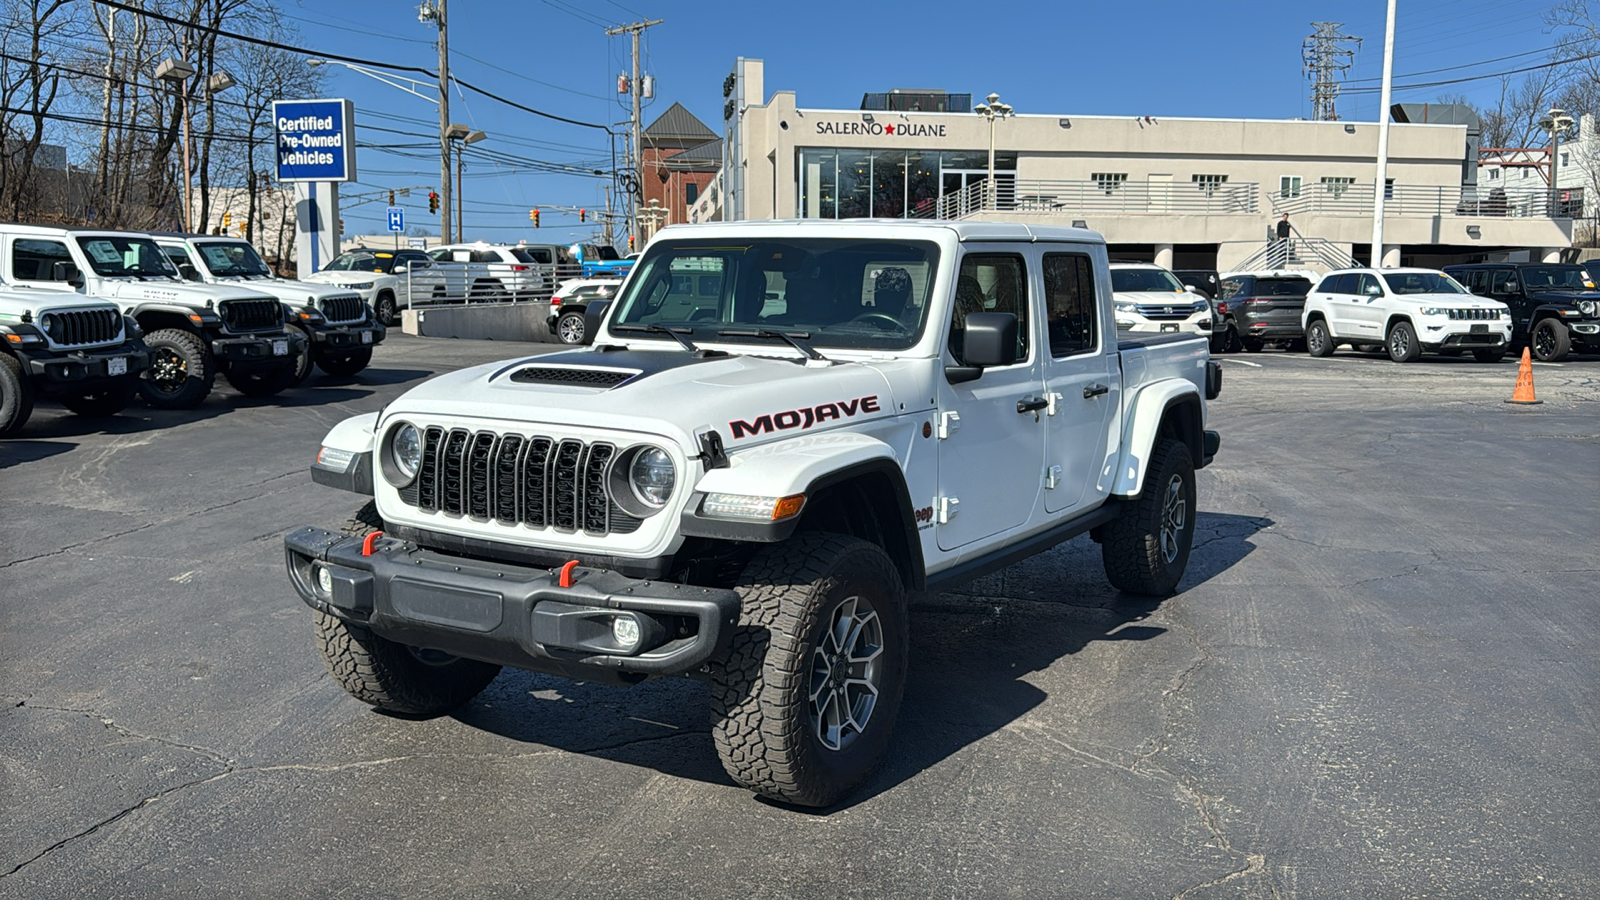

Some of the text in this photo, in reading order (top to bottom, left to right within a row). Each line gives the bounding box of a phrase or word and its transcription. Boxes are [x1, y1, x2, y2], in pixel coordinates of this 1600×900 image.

[278, 116, 333, 131] Certified
[816, 121, 946, 137] SALERNO DUANE
[279, 133, 341, 148] Pre-Owned
[280, 151, 334, 165] Vehicles
[391, 213, 401, 225] H
[728, 395, 881, 440] MOJAVE
[915, 506, 933, 523] eep
